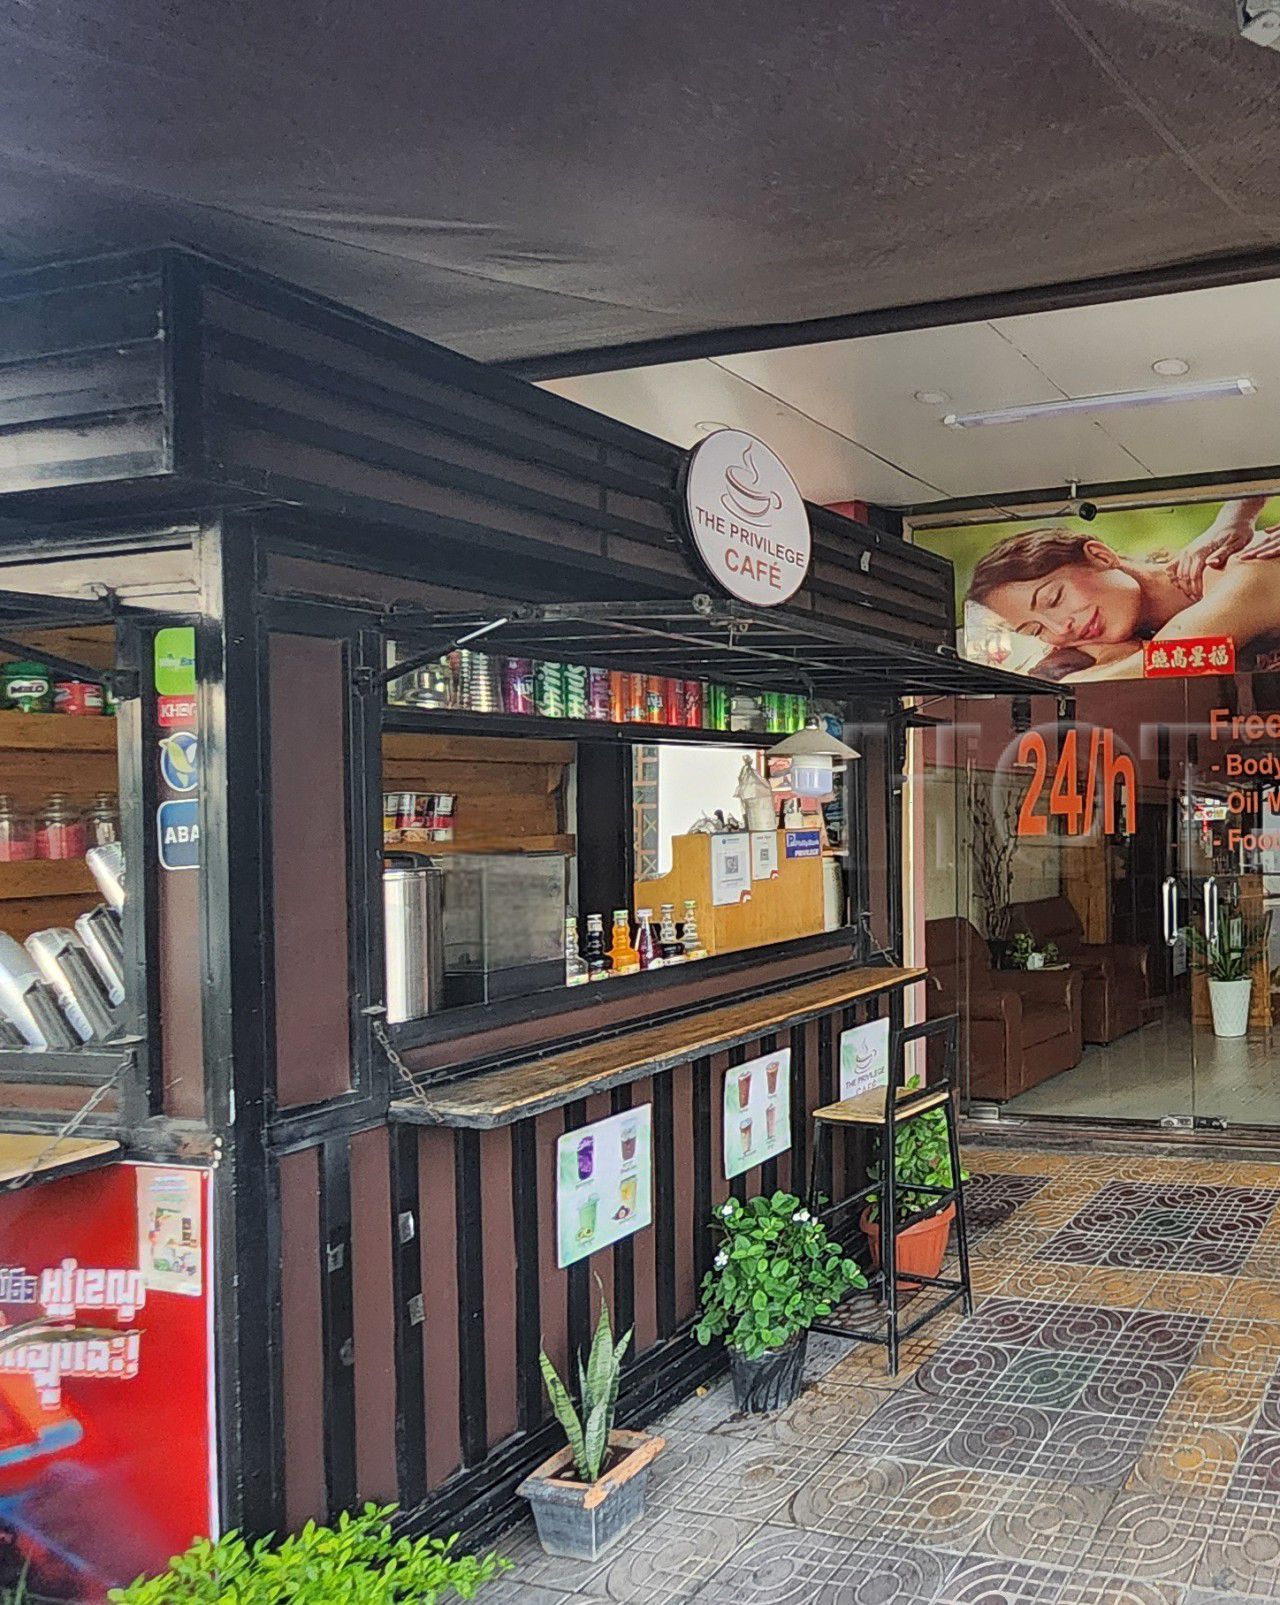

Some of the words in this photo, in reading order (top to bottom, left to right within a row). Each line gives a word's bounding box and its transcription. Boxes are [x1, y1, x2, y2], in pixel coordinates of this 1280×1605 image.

[695, 506, 726, 535] THE
[730, 523, 805, 568] PRIVILEGE
[725, 548, 782, 590] CAFÉ
[1017, 727, 1137, 837] 24/h
[1227, 790, 1259, 815] Oil
[164, 824, 200, 845] ABA
[1228, 828, 1280, 852] Foot
